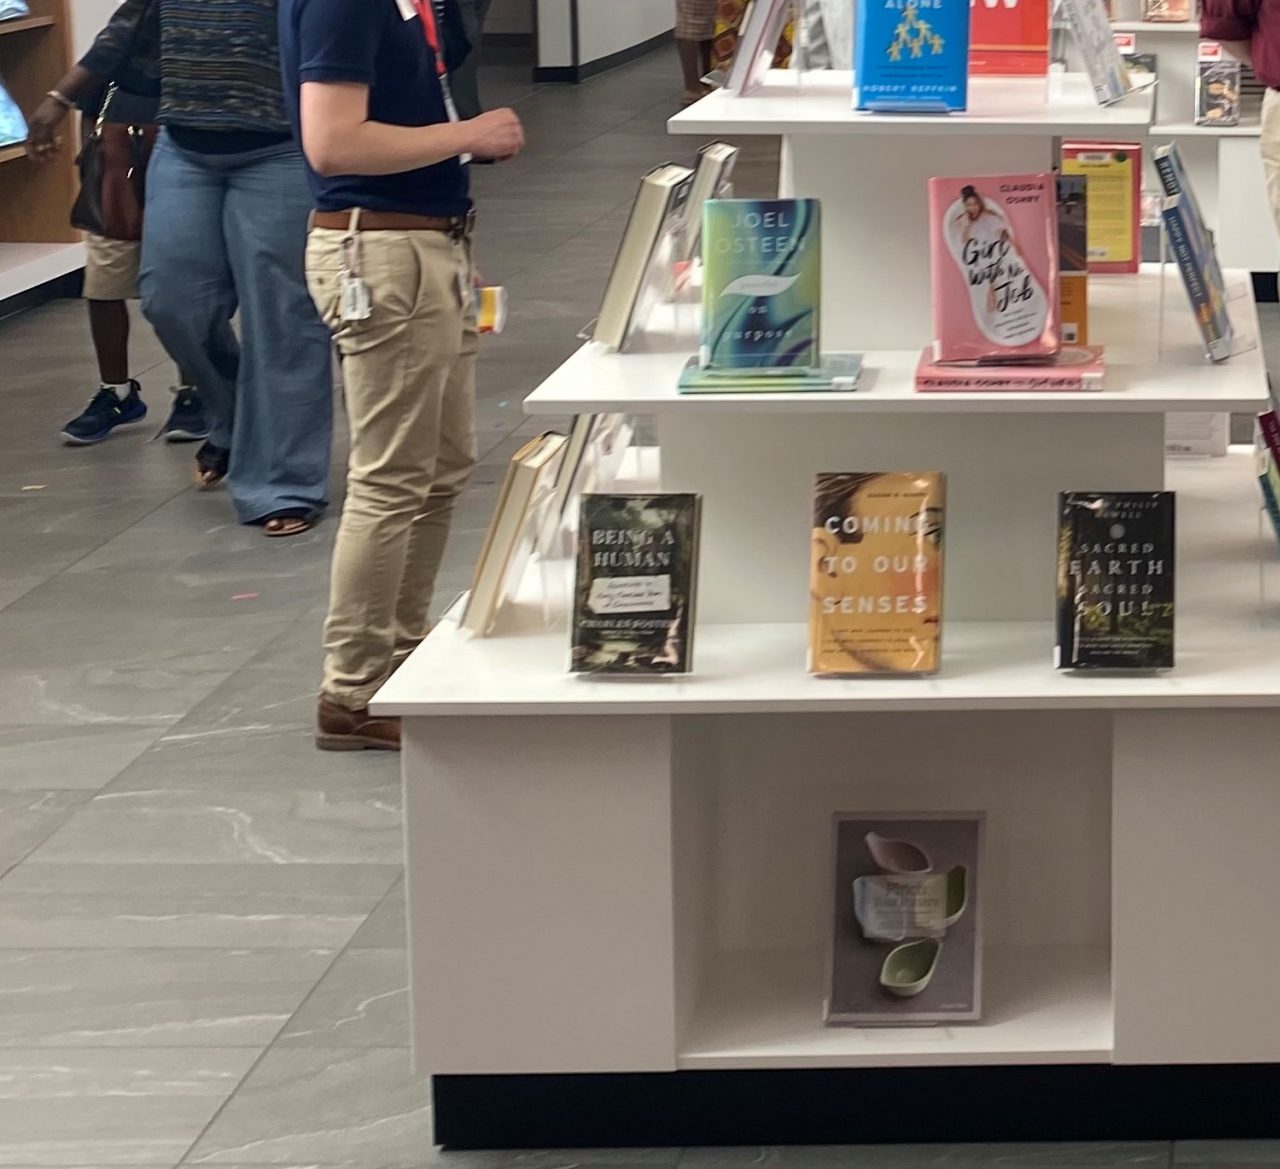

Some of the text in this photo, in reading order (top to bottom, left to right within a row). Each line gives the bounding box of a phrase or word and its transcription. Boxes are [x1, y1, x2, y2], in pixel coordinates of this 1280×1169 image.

[732, 211, 790, 229] JOEL
[962, 229, 1010, 265] Girl
[993, 274, 1034, 313] Job
[824, 516, 930, 534] COMING
[592, 529, 675, 545] BEING A
[1079, 542, 1154, 554] SACRED
[594, 551, 672, 567] HUMAN
[825, 555, 928, 573] TO OUR
[1069, 559, 1164, 576] EARTH
[1078, 583, 1154, 595] SACRED
[822, 596, 928, 614] SENSES
[1078, 600, 1154, 616] SOUL
